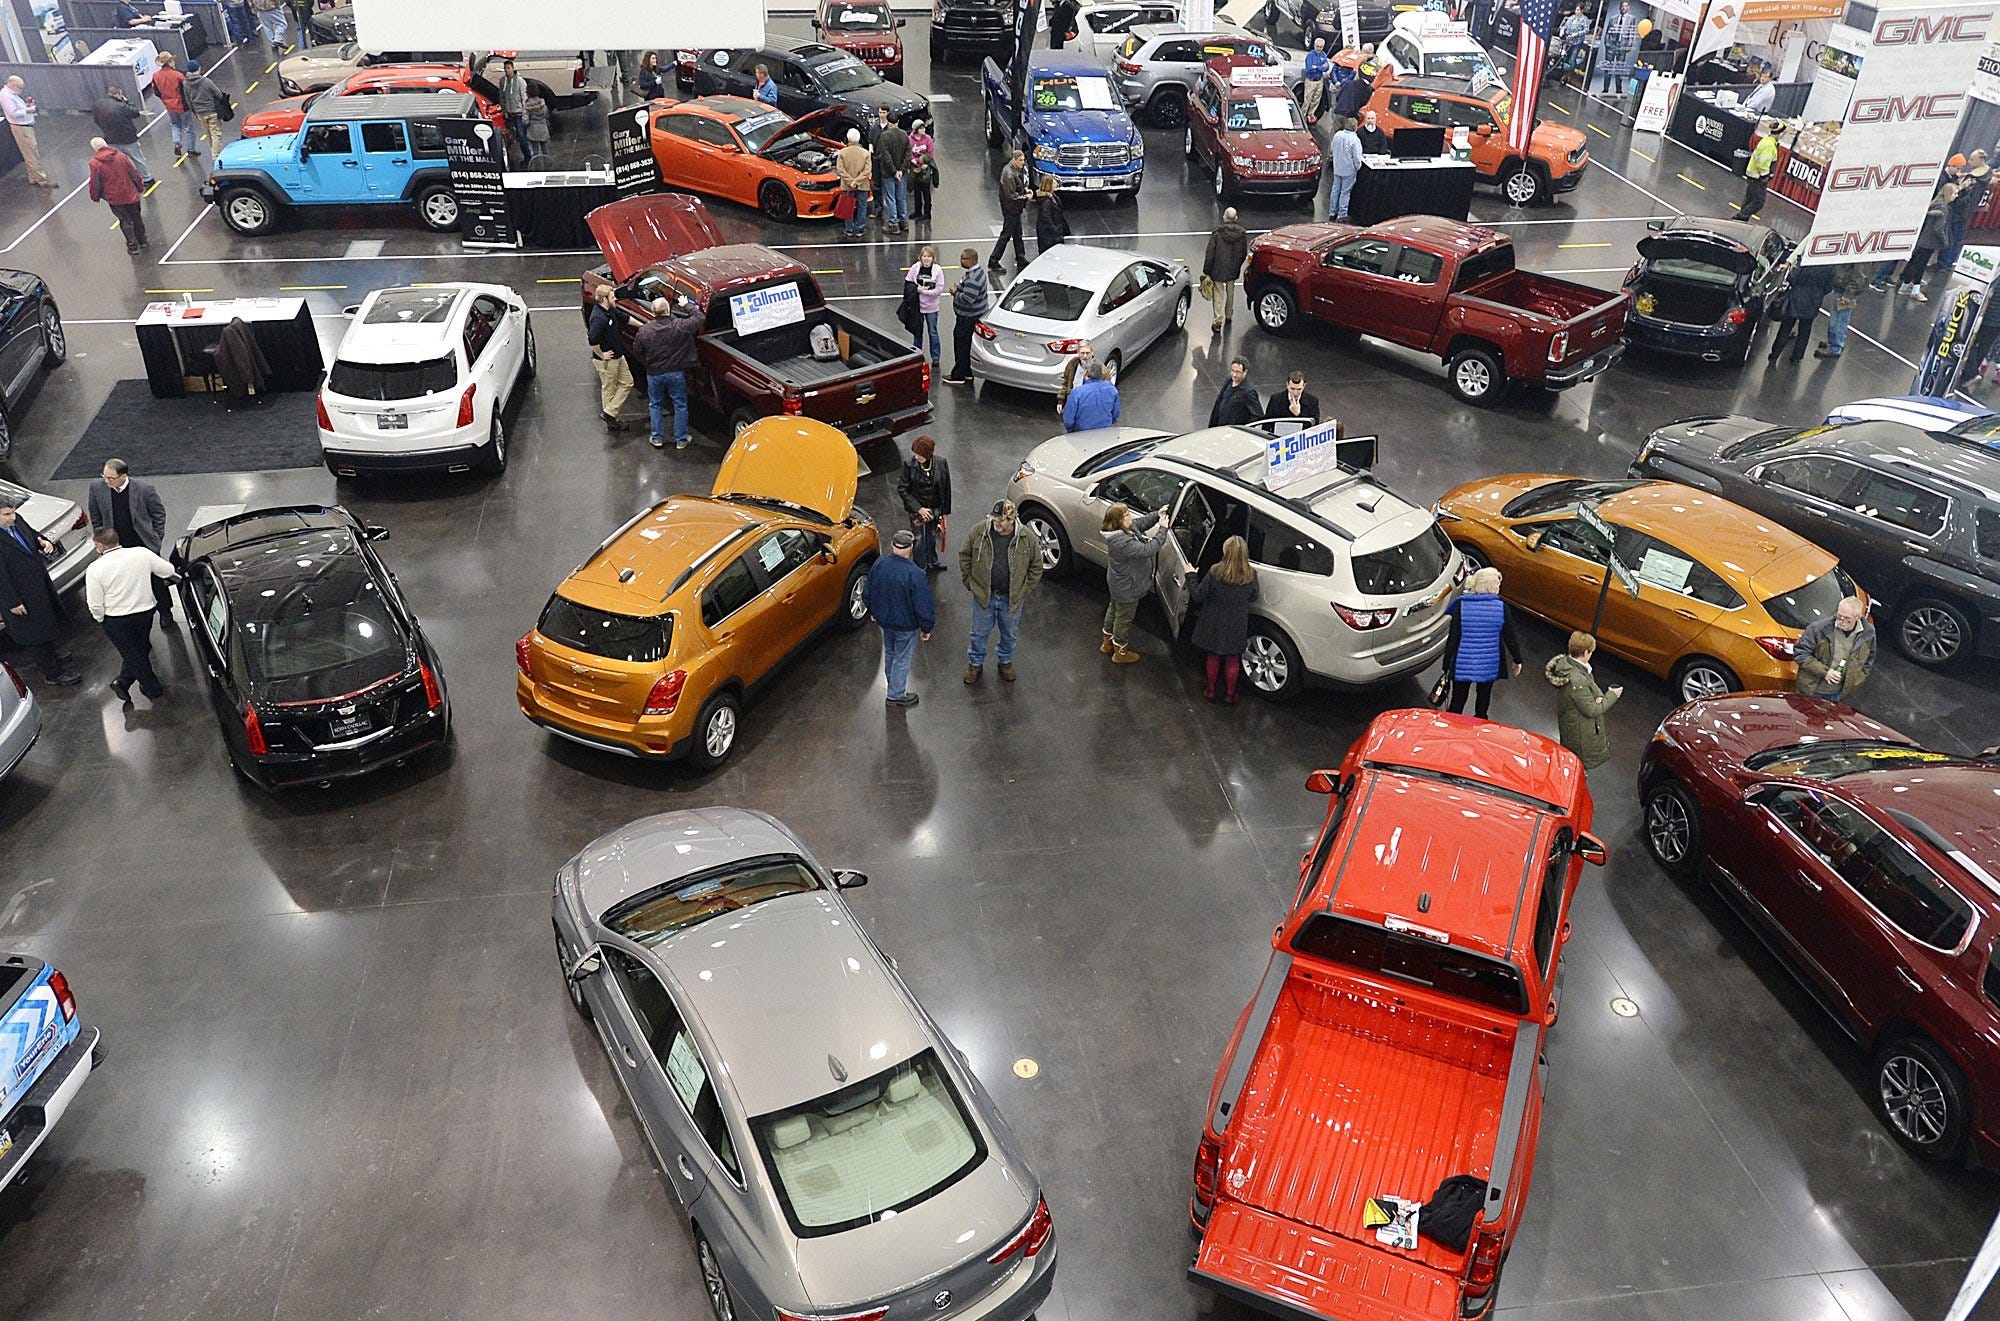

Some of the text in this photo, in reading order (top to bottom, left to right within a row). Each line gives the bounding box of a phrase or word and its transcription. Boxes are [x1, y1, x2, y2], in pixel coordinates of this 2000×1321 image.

[1873, 12, 1994, 46] GMC
[1643, 105, 1665, 117] FREE
[1850, 92, 1966, 125] GMC
[445, 137, 467, 147] Gary
[613, 129, 630, 140] Gary
[614, 136, 642, 150] Miller
[446, 146, 484, 156] Miller
[614, 142, 651, 157] AT THE MALL
[475, 156, 497, 164] MALL
[616, 157, 654, 175] (814) 868-3635
[451, 171, 501, 180] (814) 868-3635
[1829, 161, 1942, 193] GMC
[1808, 227, 1918, 258] GMC
[732, 288, 798, 317] Hallman
[1937, 291, 1971, 358] BUICK
[1269, 428, 1335, 467] Hallman
[19, 1030, 52, 1070] YourErie
